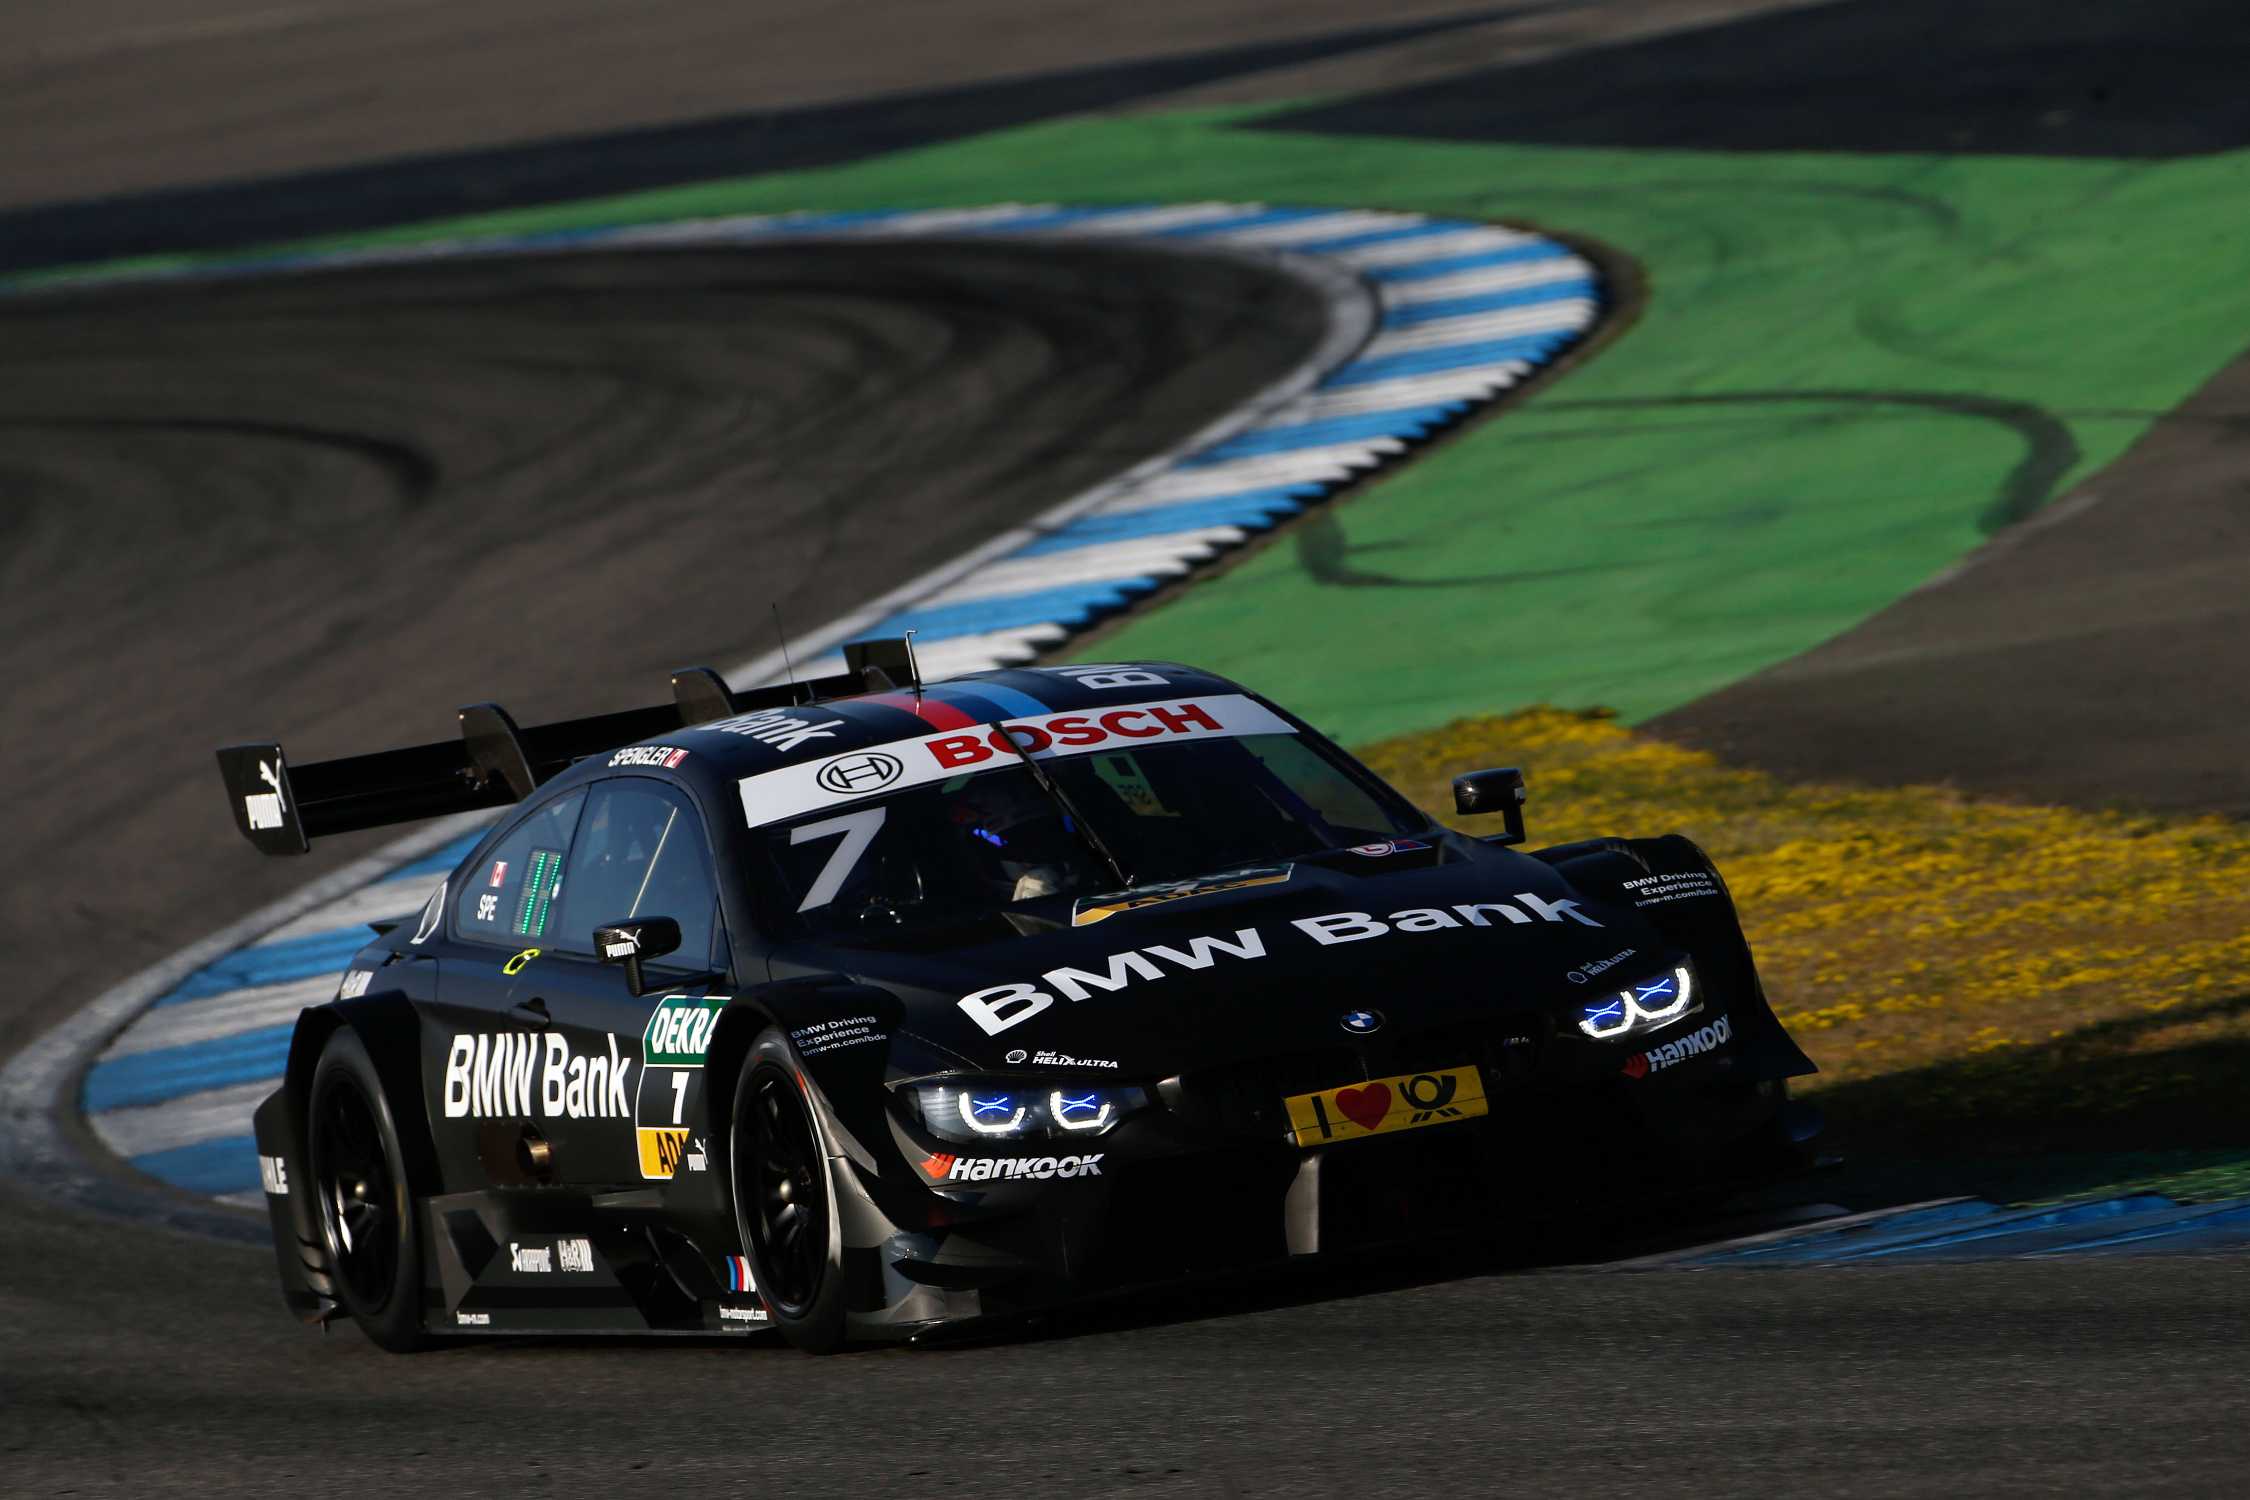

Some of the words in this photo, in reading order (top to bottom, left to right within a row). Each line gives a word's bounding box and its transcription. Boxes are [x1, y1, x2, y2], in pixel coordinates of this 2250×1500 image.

[925, 704, 1223, 769] BOSCH
[608, 746, 674, 767] SPENGLER
[790, 806, 886, 913] 7
[1623, 876, 1658, 889] BMW
[1660, 872, 1707, 882] Driving
[1640, 880, 1713, 895] Experience
[477, 894, 498, 921] SPE
[957, 928, 1266, 1036] BMW
[1290, 893, 1605, 945] Bank
[791, 1023, 826, 1039] BMW
[828, 1016, 877, 1029] Driving
[797, 1026, 870, 1047] Experience
[1032, 1054, 1076, 1066] HELIX
[1077, 1059, 1119, 1068] ULTRA
[445, 1033, 538, 1118] BMW
[542, 1032, 632, 1119] Bank
[1311, 1096, 1332, 1139] I
